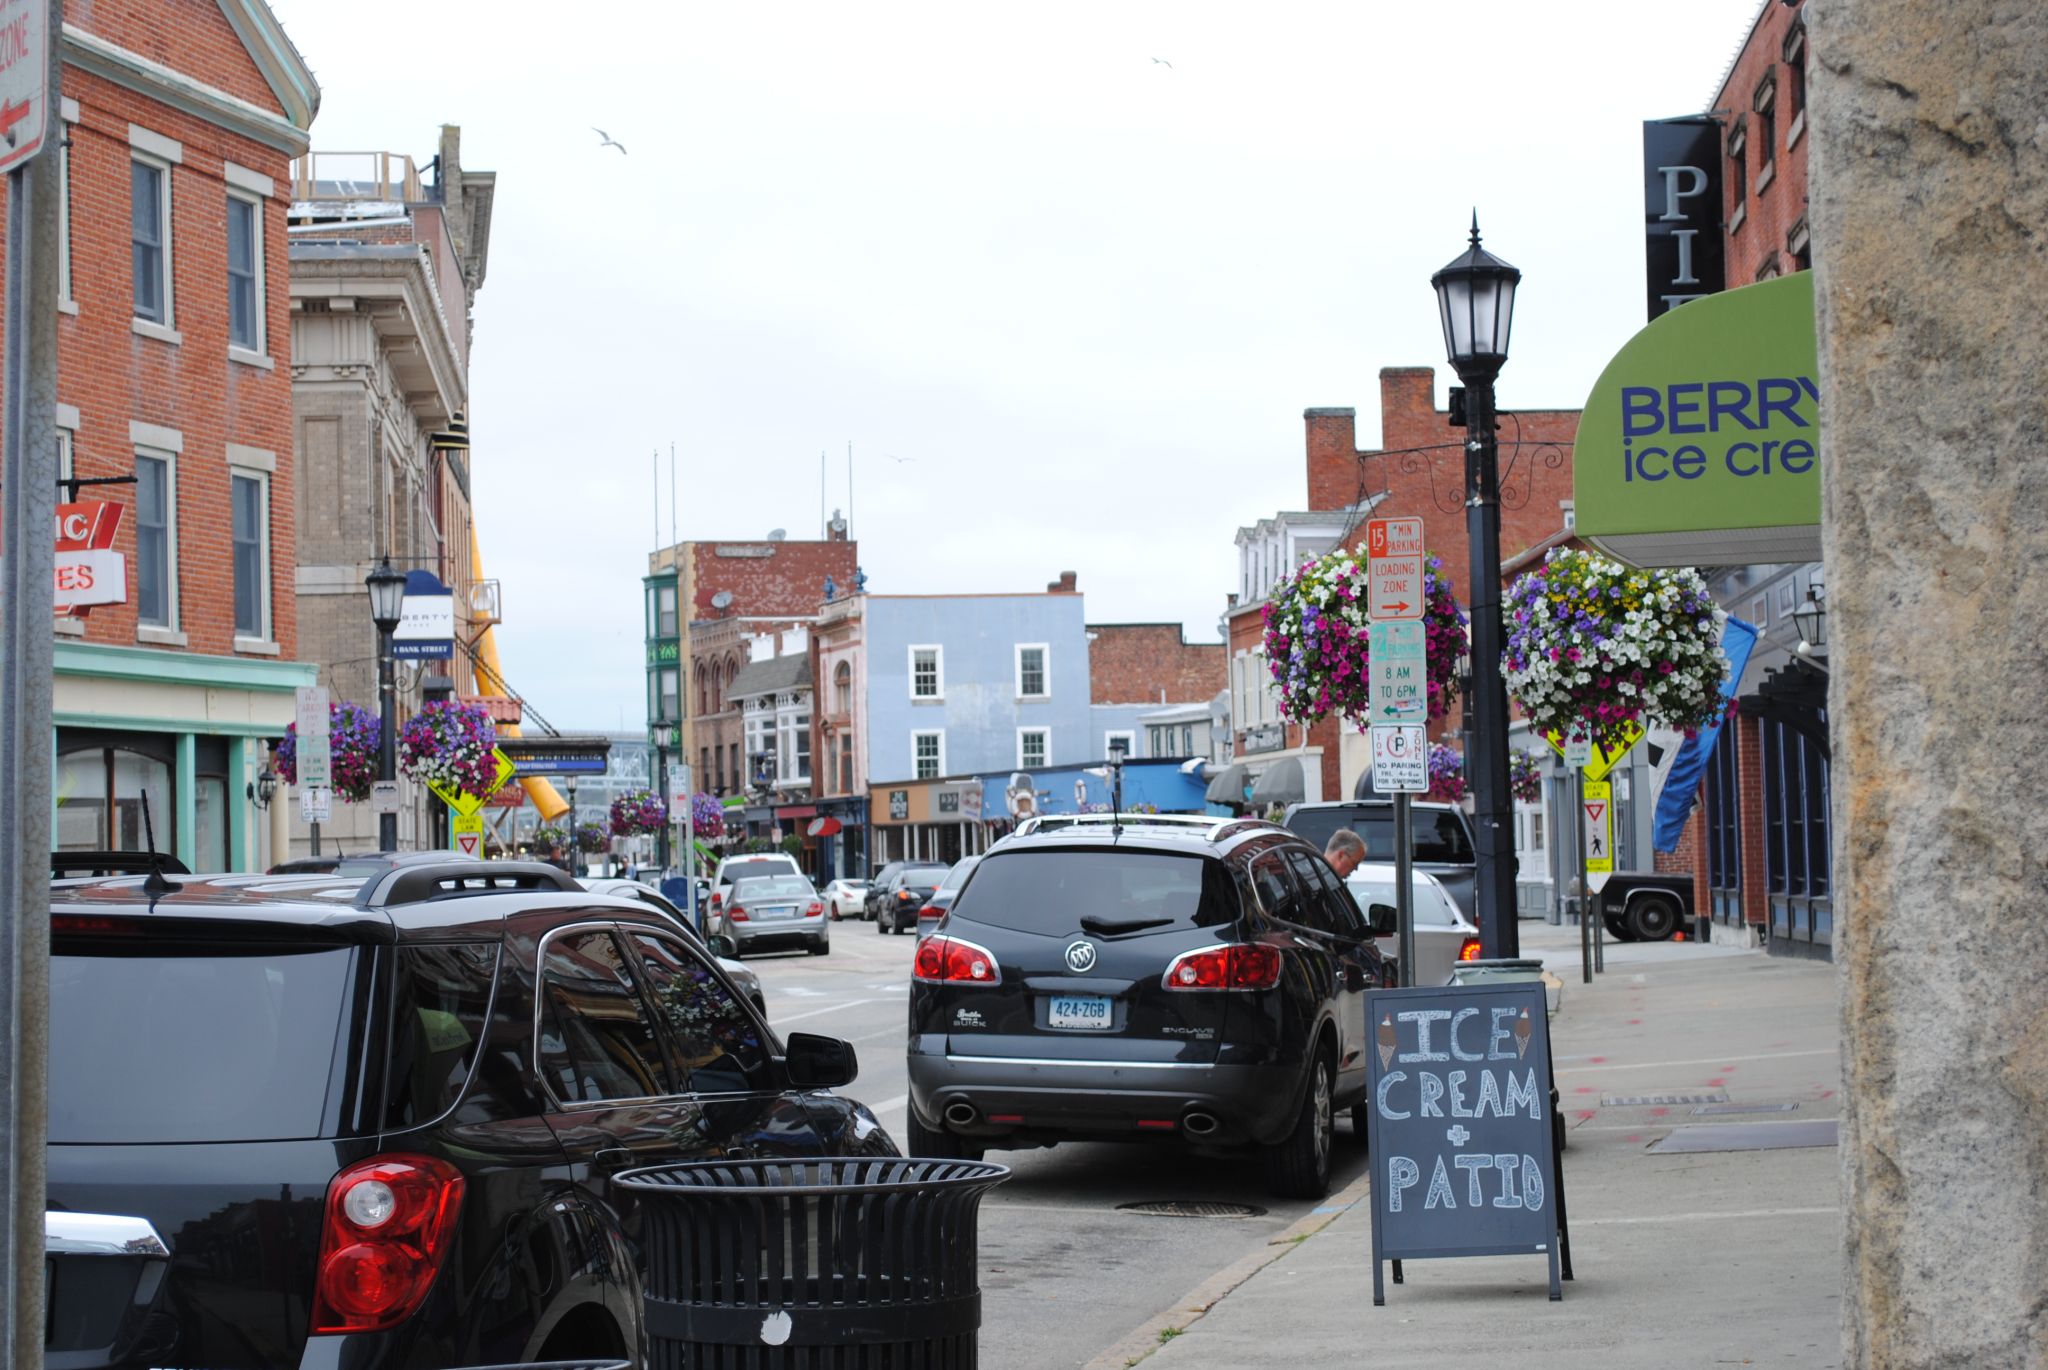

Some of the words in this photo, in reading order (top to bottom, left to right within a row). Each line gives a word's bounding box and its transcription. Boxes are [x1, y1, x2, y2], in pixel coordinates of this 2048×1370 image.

[1623, 438, 1707, 482] ice
[1725, 438, 1820, 476] cre
[1372, 528, 1384, 547] 15
[1398, 524, 1412, 536] MIN
[1387, 540, 1420, 552] PARKING
[1375, 562, 1415, 576] LOADING
[1383, 580, 1408, 593] ZONE
[1385, 667, 1392, 680] 8
[1396, 666, 1410, 679] AM
[1381, 685, 1392, 698] TO
[1396, 684, 1416, 698] 6PM
[1397, 1007, 1517, 1064] ICE
[1376, 1066, 1542, 1121] CREAM
[1388, 1154, 1545, 1213] PATIO
